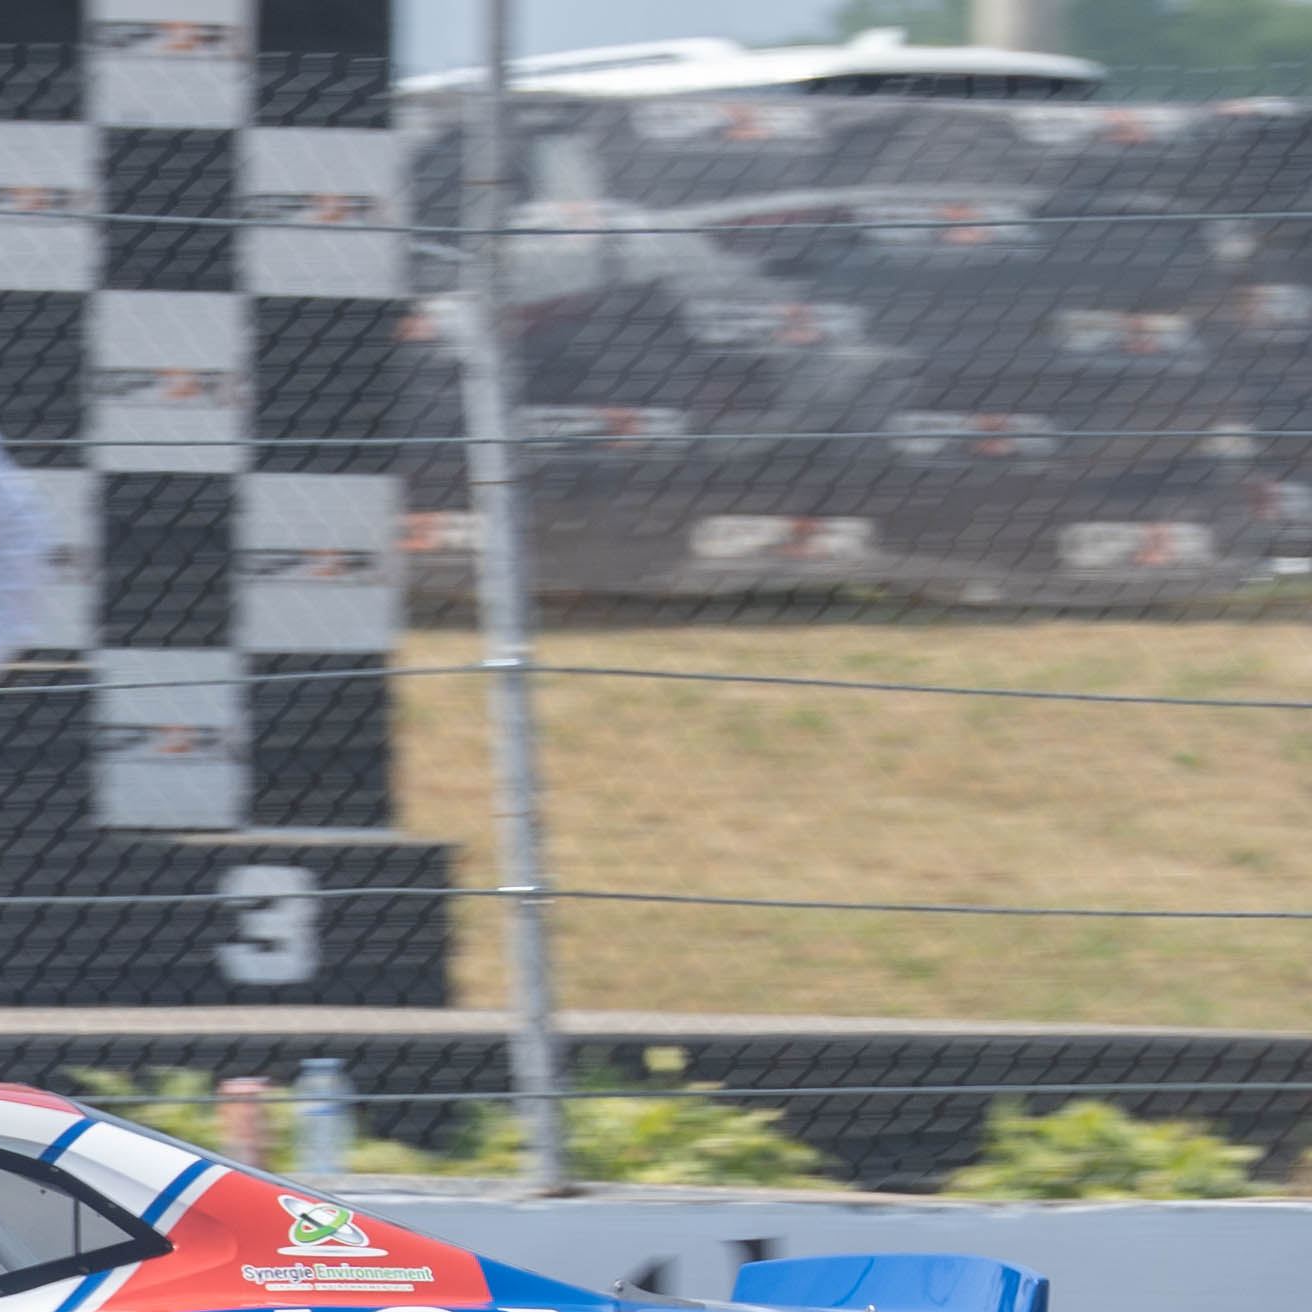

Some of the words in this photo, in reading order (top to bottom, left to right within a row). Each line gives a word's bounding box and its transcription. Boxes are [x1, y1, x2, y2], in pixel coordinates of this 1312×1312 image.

[215, 866, 322, 985] 3
[243, 1264, 313, 1283] Synergie
[316, 1264, 433, 1282] Environnement
